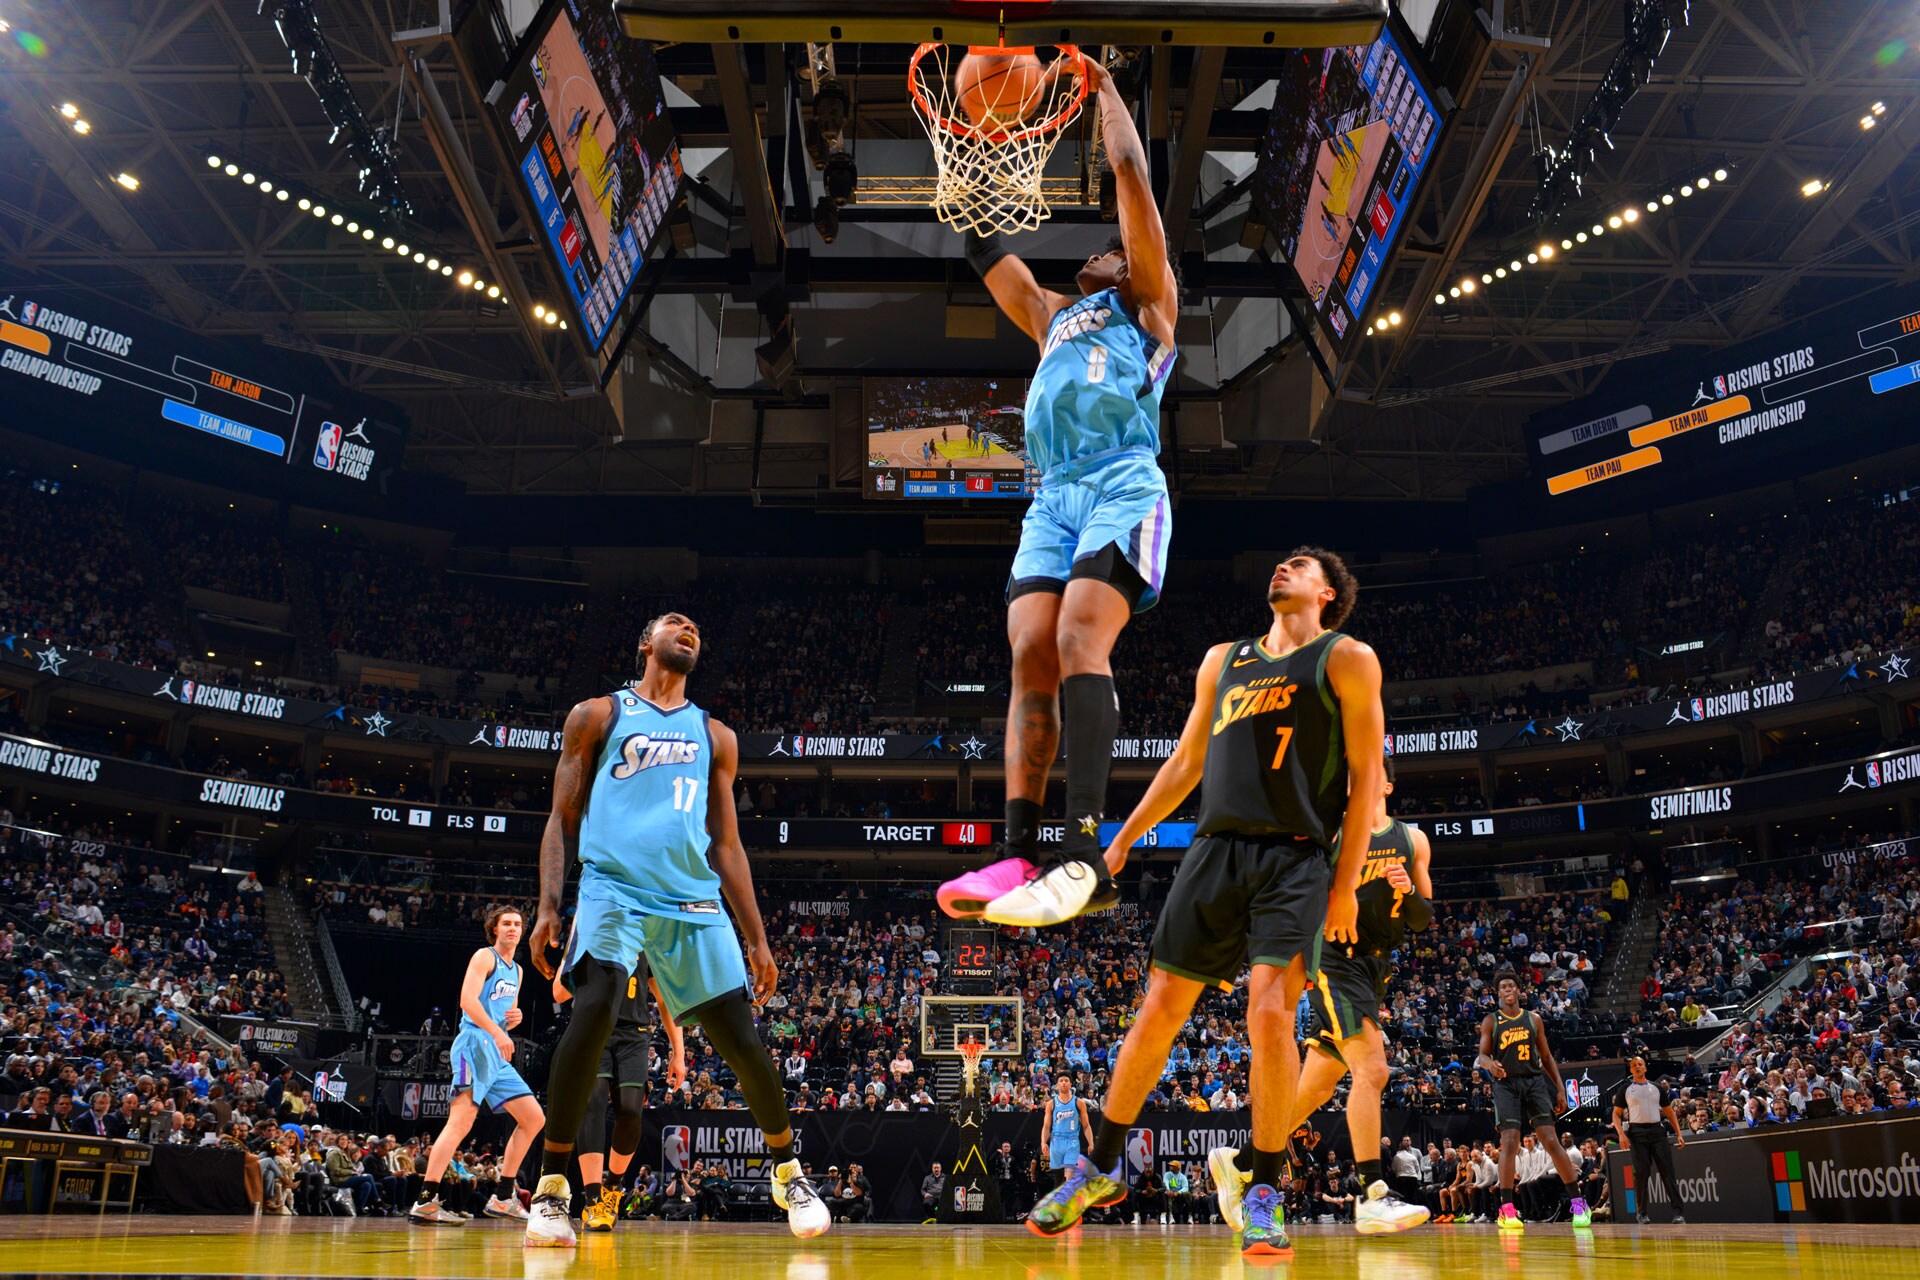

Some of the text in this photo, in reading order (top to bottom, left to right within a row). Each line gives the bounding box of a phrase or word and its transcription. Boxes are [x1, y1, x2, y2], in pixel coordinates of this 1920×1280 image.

[86, 325, 133, 357] STARS
[0, 348, 102, 396] CHAMPIONSHIP
[1773, 346, 1815, 378] STARS
[209, 371, 262, 401] TEAM JASON
[198, 413, 253, 443] TEAM JOAKIM
[1571, 416, 1619, 443] TEAM DERON
[1669, 410, 1709, 433] TEAM PAU
[1719, 399, 1806, 444] CHAMPIONSHIP
[339, 441, 375, 466] RISING
[336, 457, 370, 481] STARS
[950, 470, 955, 480] 9
[1585, 459, 1622, 482] TEAM PAU
[949, 484, 956, 494] 15
[975, 479, 984, 490] 40
[1248, 676, 1288, 688] RISING
[242, 692, 285, 719] STARS
[1753, 681, 1794, 709] STARS
[1213, 684, 1298, 736] STARS
[848, 738, 886, 757] STARS
[1112, 739, 1179, 758] SING STARS
[1271, 727, 1294, 770] 7
[1440, 730, 1478, 751] STARS
[51, 753, 100, 782] STARS
[614, 734, 700, 779] STARS
[1883, 754, 1920, 784] RISIN
[200, 779, 285, 812] SEMIFINALS
[672, 776, 699, 813] 17
[1651, 787, 1732, 820] SEMIFINALS
[372, 807, 500, 830] TOL 1 FLS 0
[1435, 821, 1487, 836] FLS 1
[779, 822, 975, 844] 9 TARGET 40
[1143, 825, 1157, 846] 15
[70, 840, 106, 857] 2023
[1873, 842, 1907, 862] 2023
[1390, 888, 1404, 918] 2
[960, 946, 987, 966] 22
[627, 976, 638, 1000] 6
[1500, 1030, 1530, 1050] STARS
[1518, 1045, 1530, 1061] 25
[423, 1103, 450, 1115] UTAH
[65, 1178, 96, 1194] FRIDAY
[1648, 1167, 1720, 1203] Miosoft
[1808, 1152, 1920, 1199] Microsoft
[967, 1203, 984, 1212] STARS
